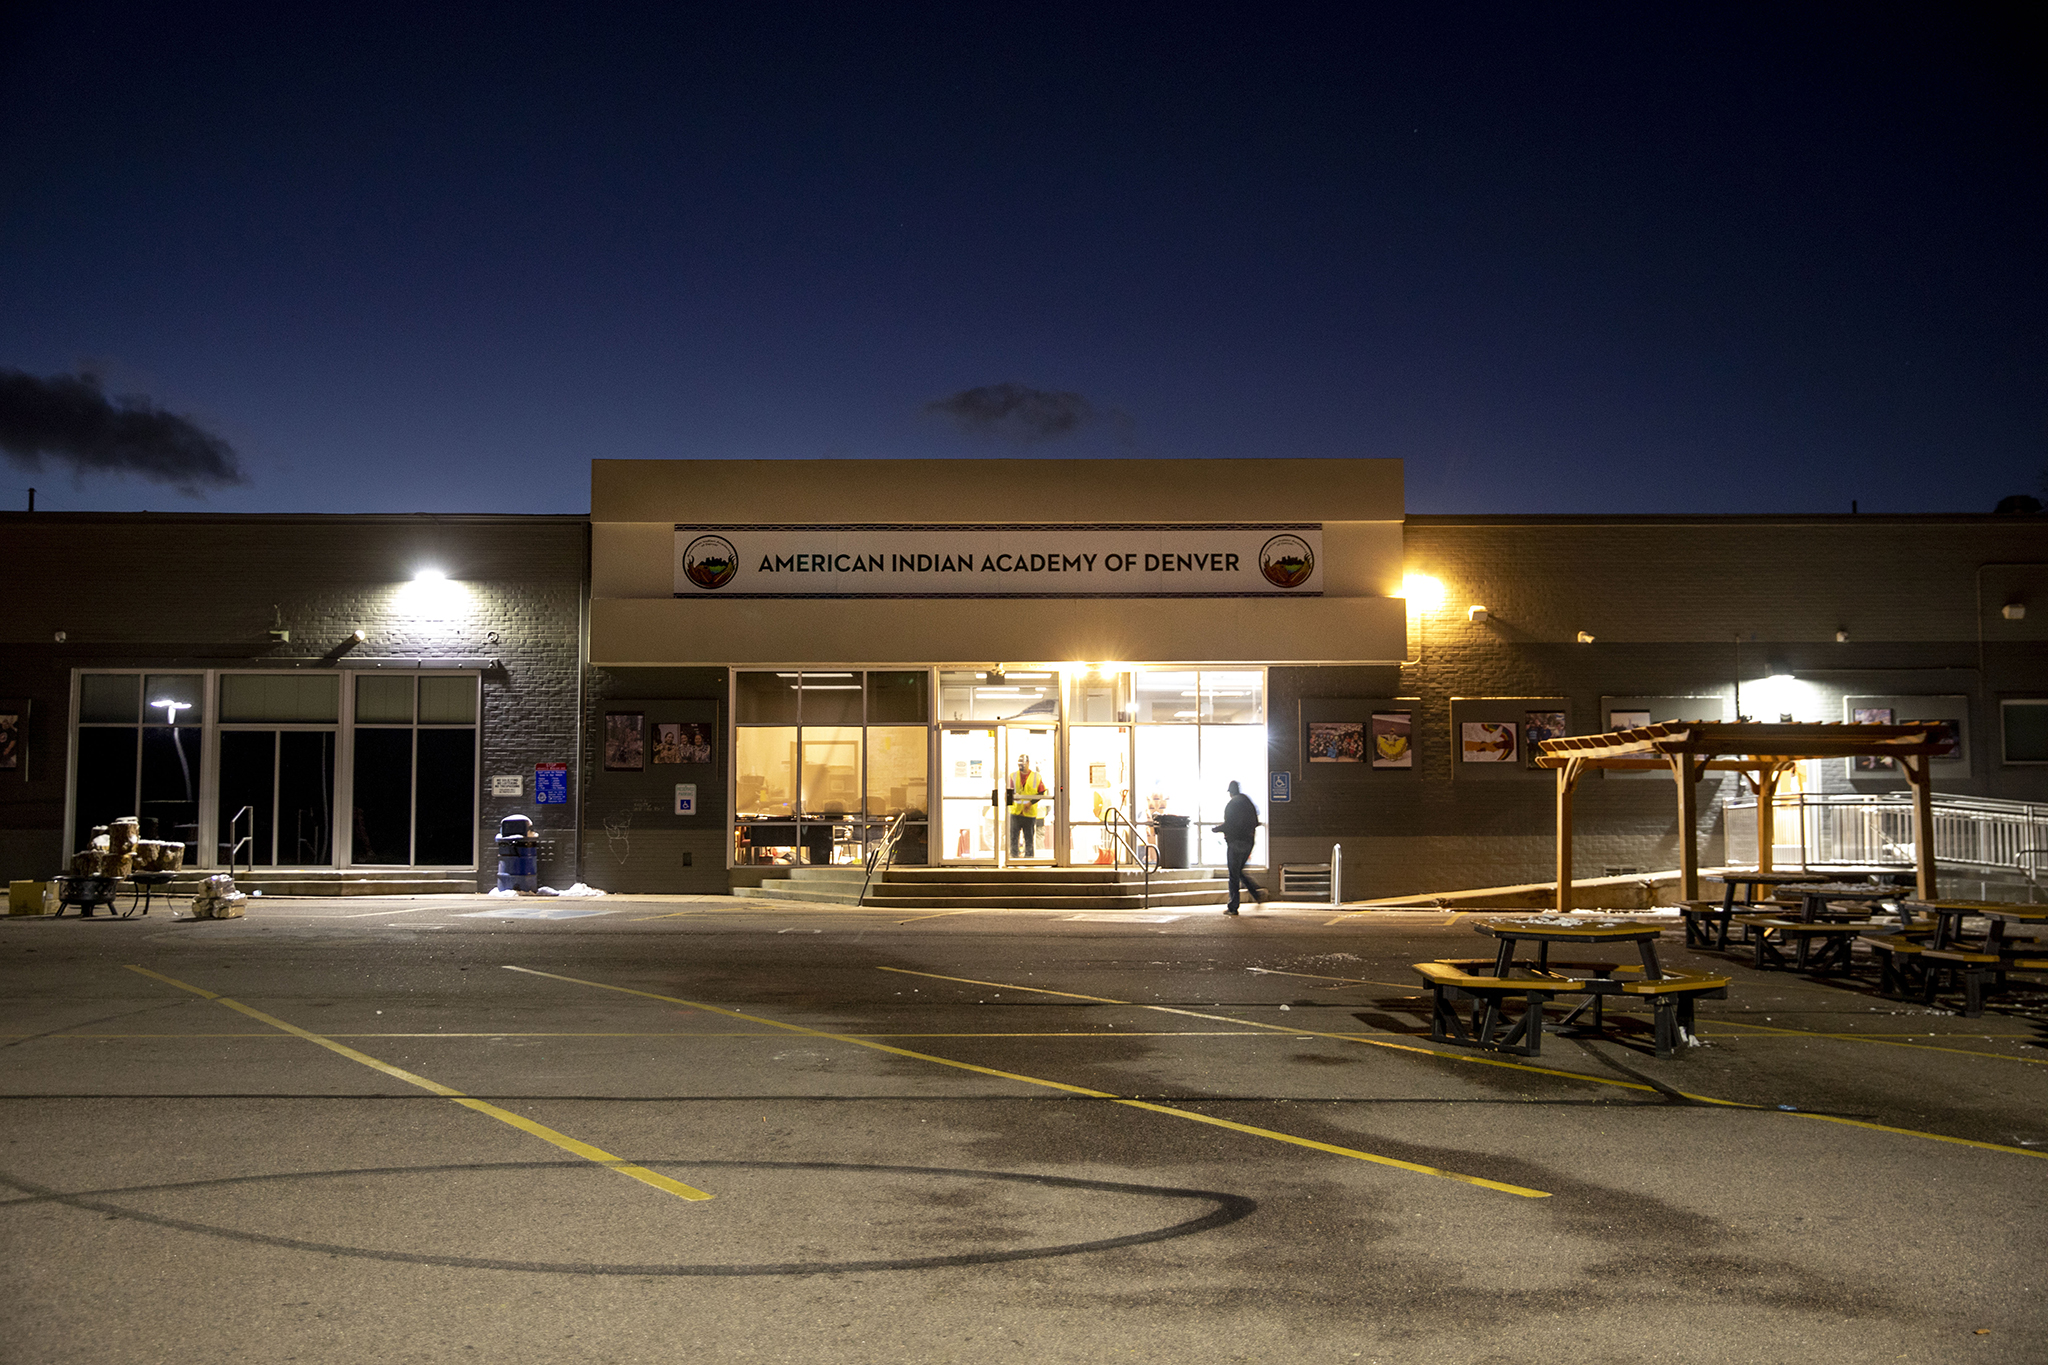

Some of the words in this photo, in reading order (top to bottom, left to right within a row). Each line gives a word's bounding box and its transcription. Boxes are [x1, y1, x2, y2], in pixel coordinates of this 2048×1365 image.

[758, 553, 884, 573] AMERICAN
[892, 553, 973, 573] INDIAN
[980, 553, 1098, 573] ACADEMY
[1104, 553, 1137, 572] OF
[1144, 553, 1240, 572] DENVER
